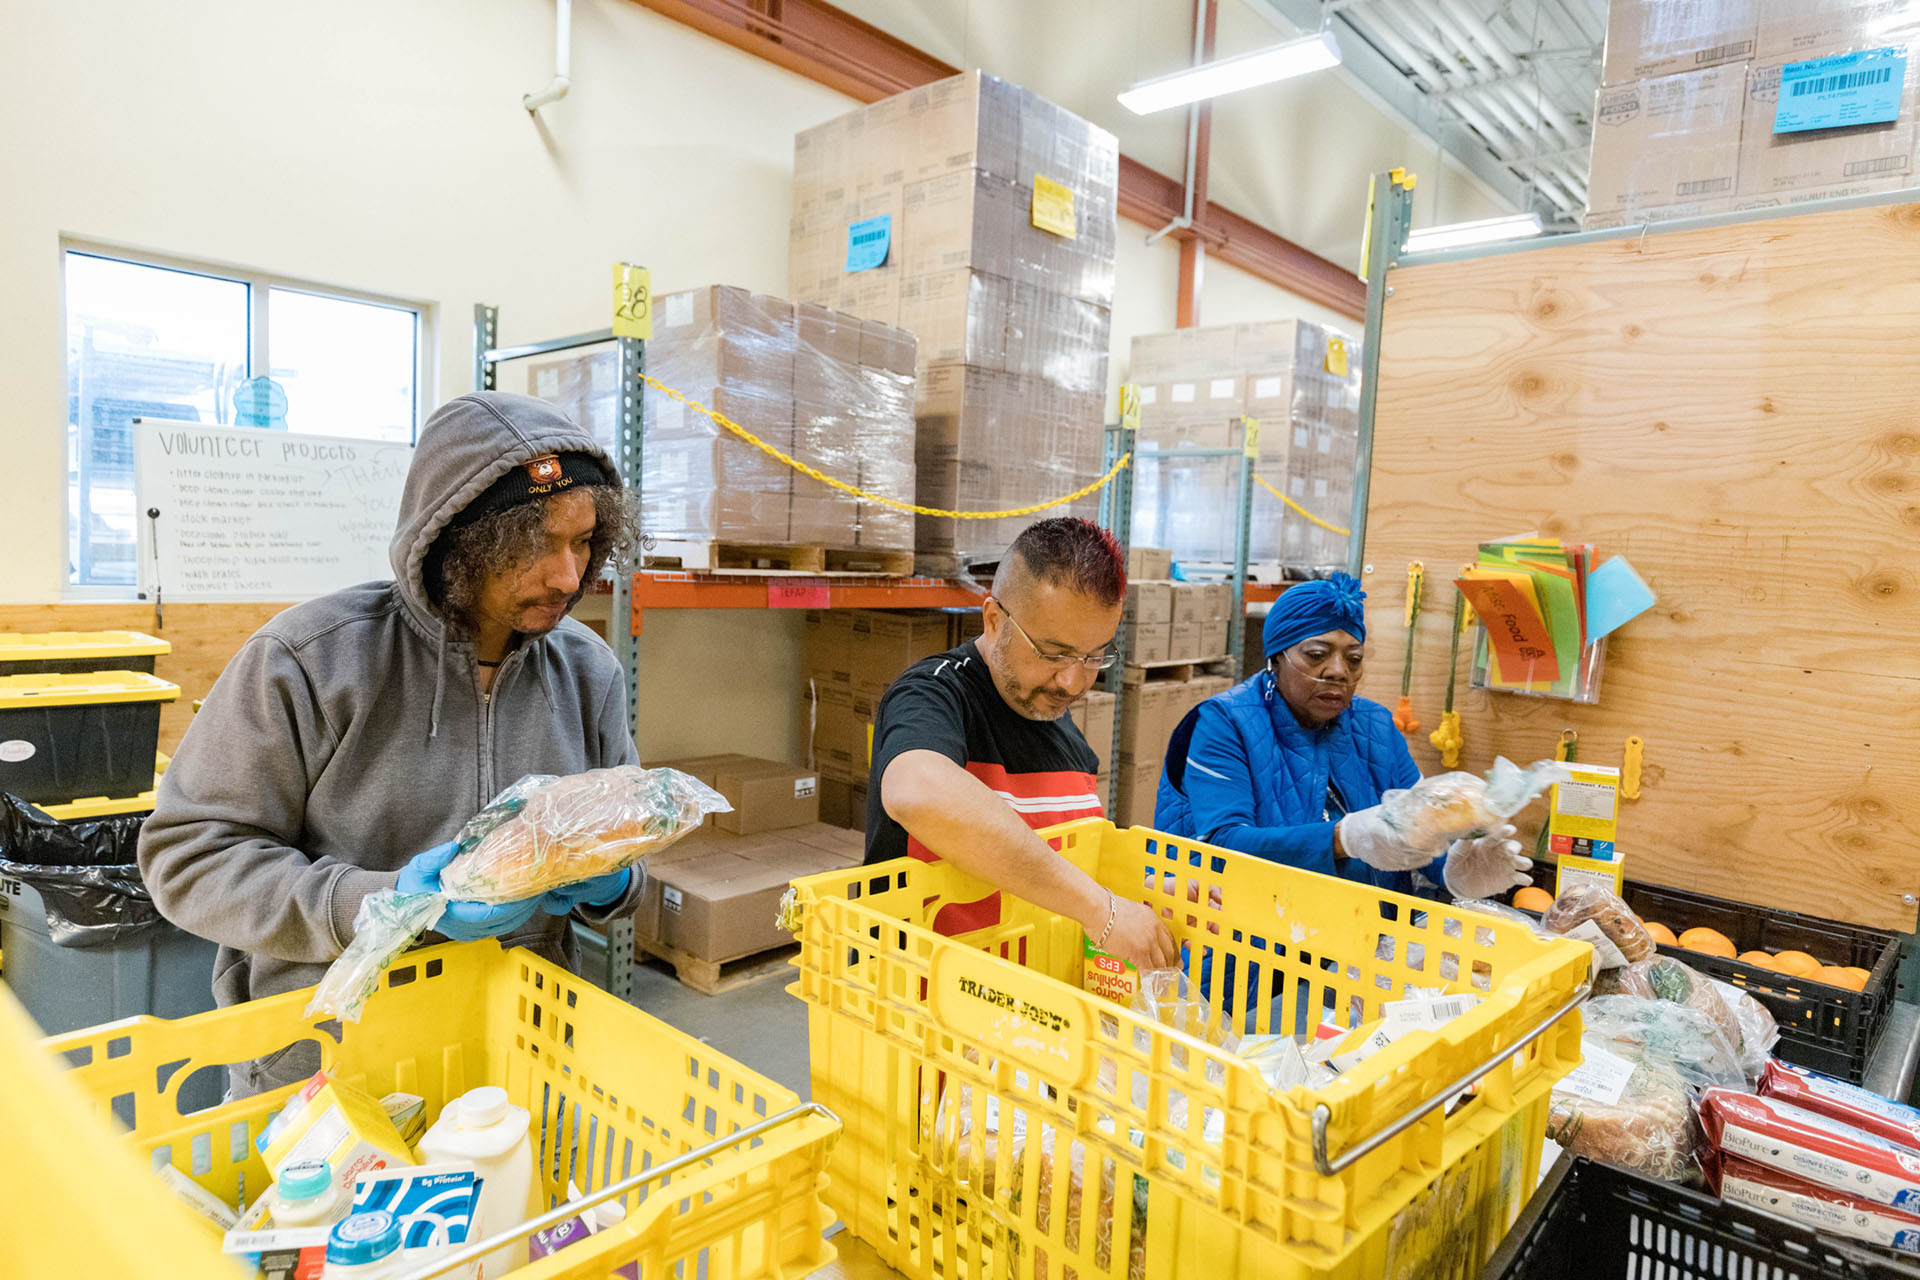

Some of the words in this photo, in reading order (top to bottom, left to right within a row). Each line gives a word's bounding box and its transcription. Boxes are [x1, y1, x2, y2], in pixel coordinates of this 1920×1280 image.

[616, 282, 647, 320] 28
[528, 482, 552, 494] ONLY
[556, 475, 573, 488] YOU
[1099, 957, 1120, 972] EPS
[1088, 970, 1132, 993] Dophilus
[958, 976, 1016, 1010] TRADER
[1019, 1001, 1064, 1033] JOE'S
[1723, 1129, 1771, 1155] BioPure
[1792, 1153, 1849, 1178] DISINFECTING
[1722, 1180, 1771, 1205] BioPure
[1791, 1201, 1848, 1223] DISINFECTING
